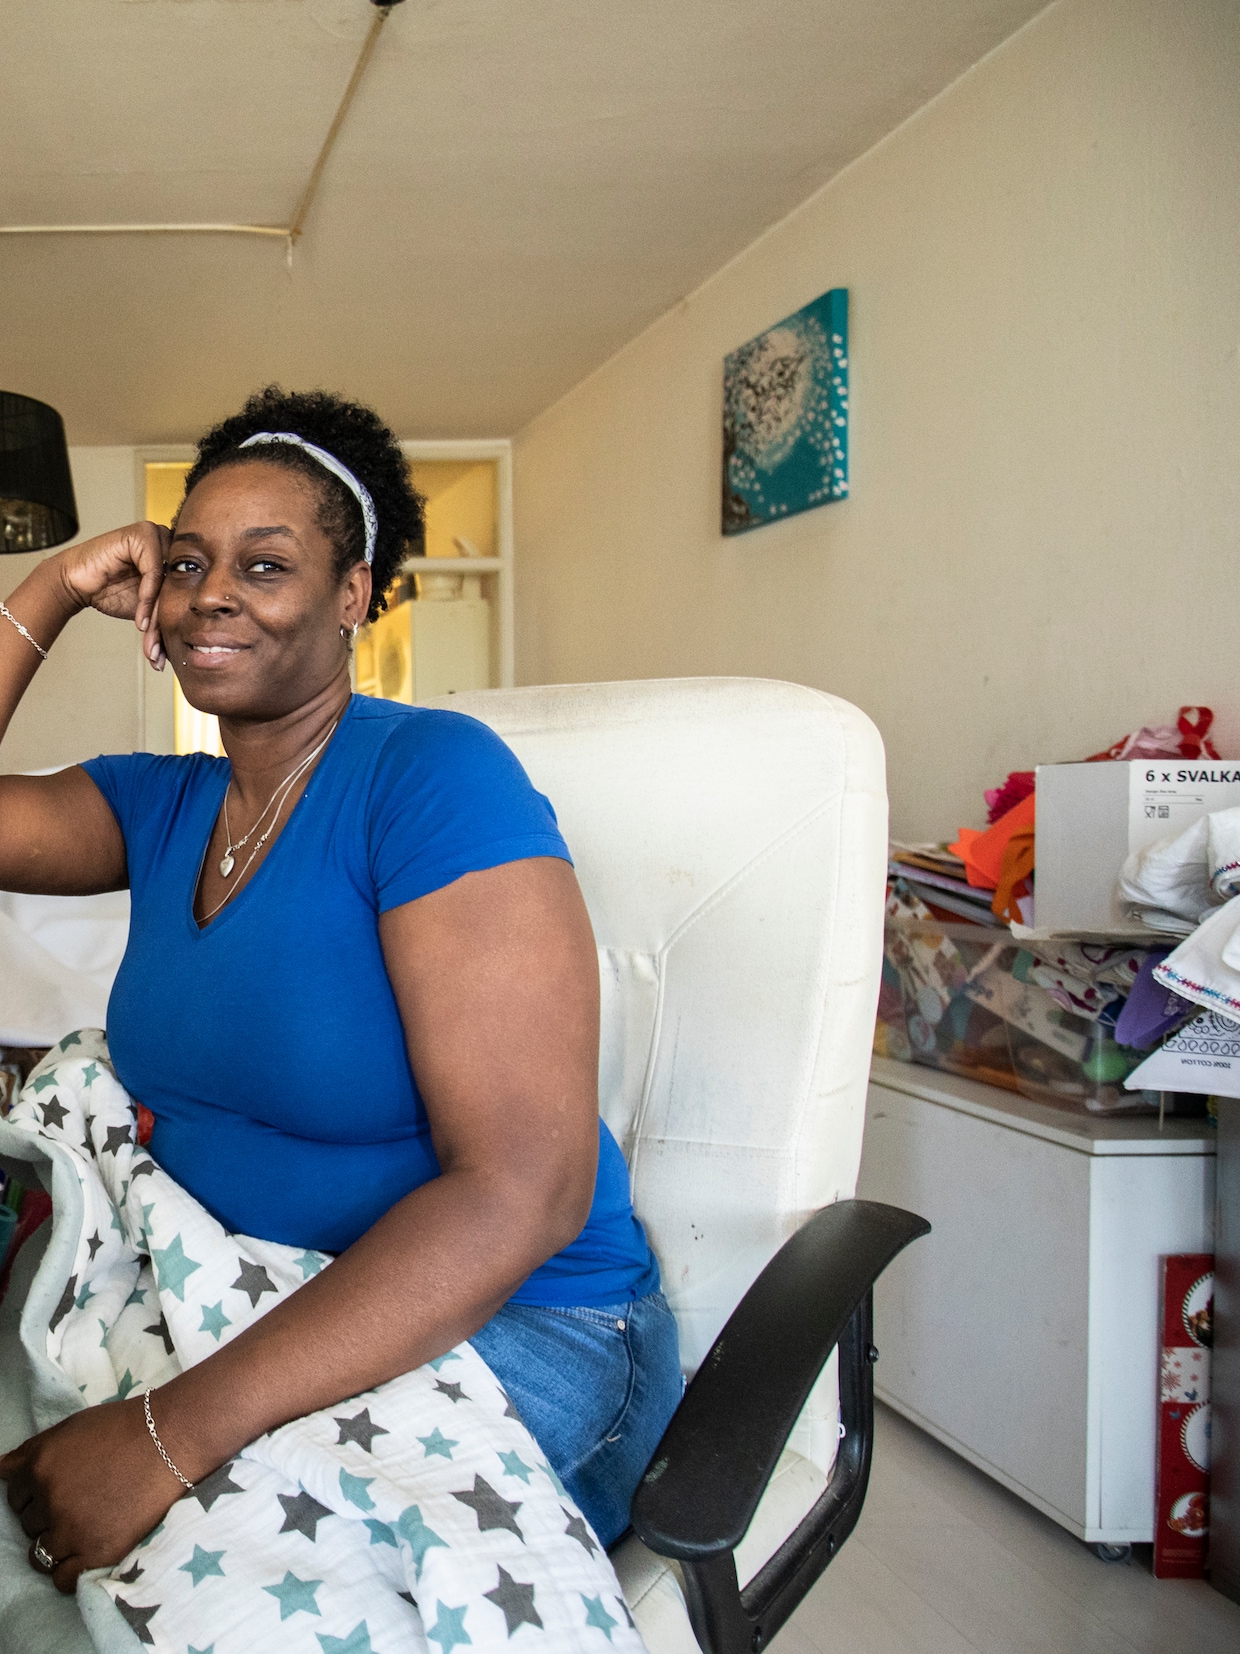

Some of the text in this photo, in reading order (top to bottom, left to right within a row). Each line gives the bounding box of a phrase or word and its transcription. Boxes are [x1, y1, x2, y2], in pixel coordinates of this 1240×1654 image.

[1145, 769, 1240, 783] 6 x SVALKA
